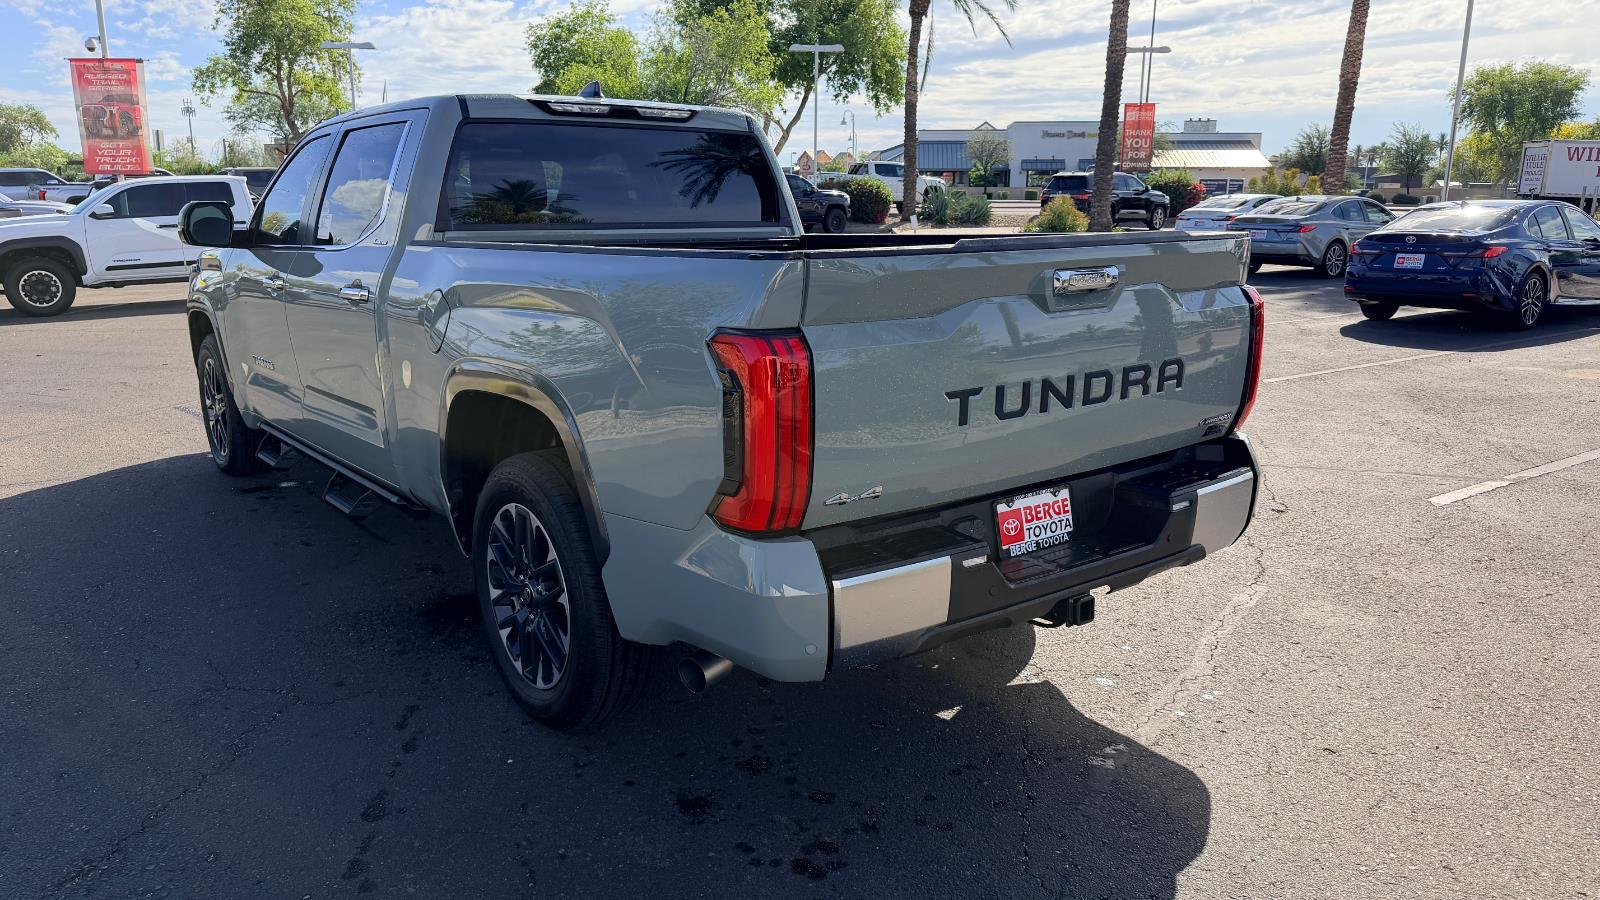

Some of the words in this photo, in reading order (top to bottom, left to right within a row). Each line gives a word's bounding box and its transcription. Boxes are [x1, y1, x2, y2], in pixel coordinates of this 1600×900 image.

[1126, 138, 1150, 148] YOU
[1128, 151, 1145, 159] FOR
[944, 357, 1186, 427] TUNDRA
[1022, 497, 1070, 524] BERGE
[1026, 518, 1072, 540] TOYOTA
[1010, 541, 1037, 557] BERGE
[1039, 533, 1069, 549] TOYOTA
